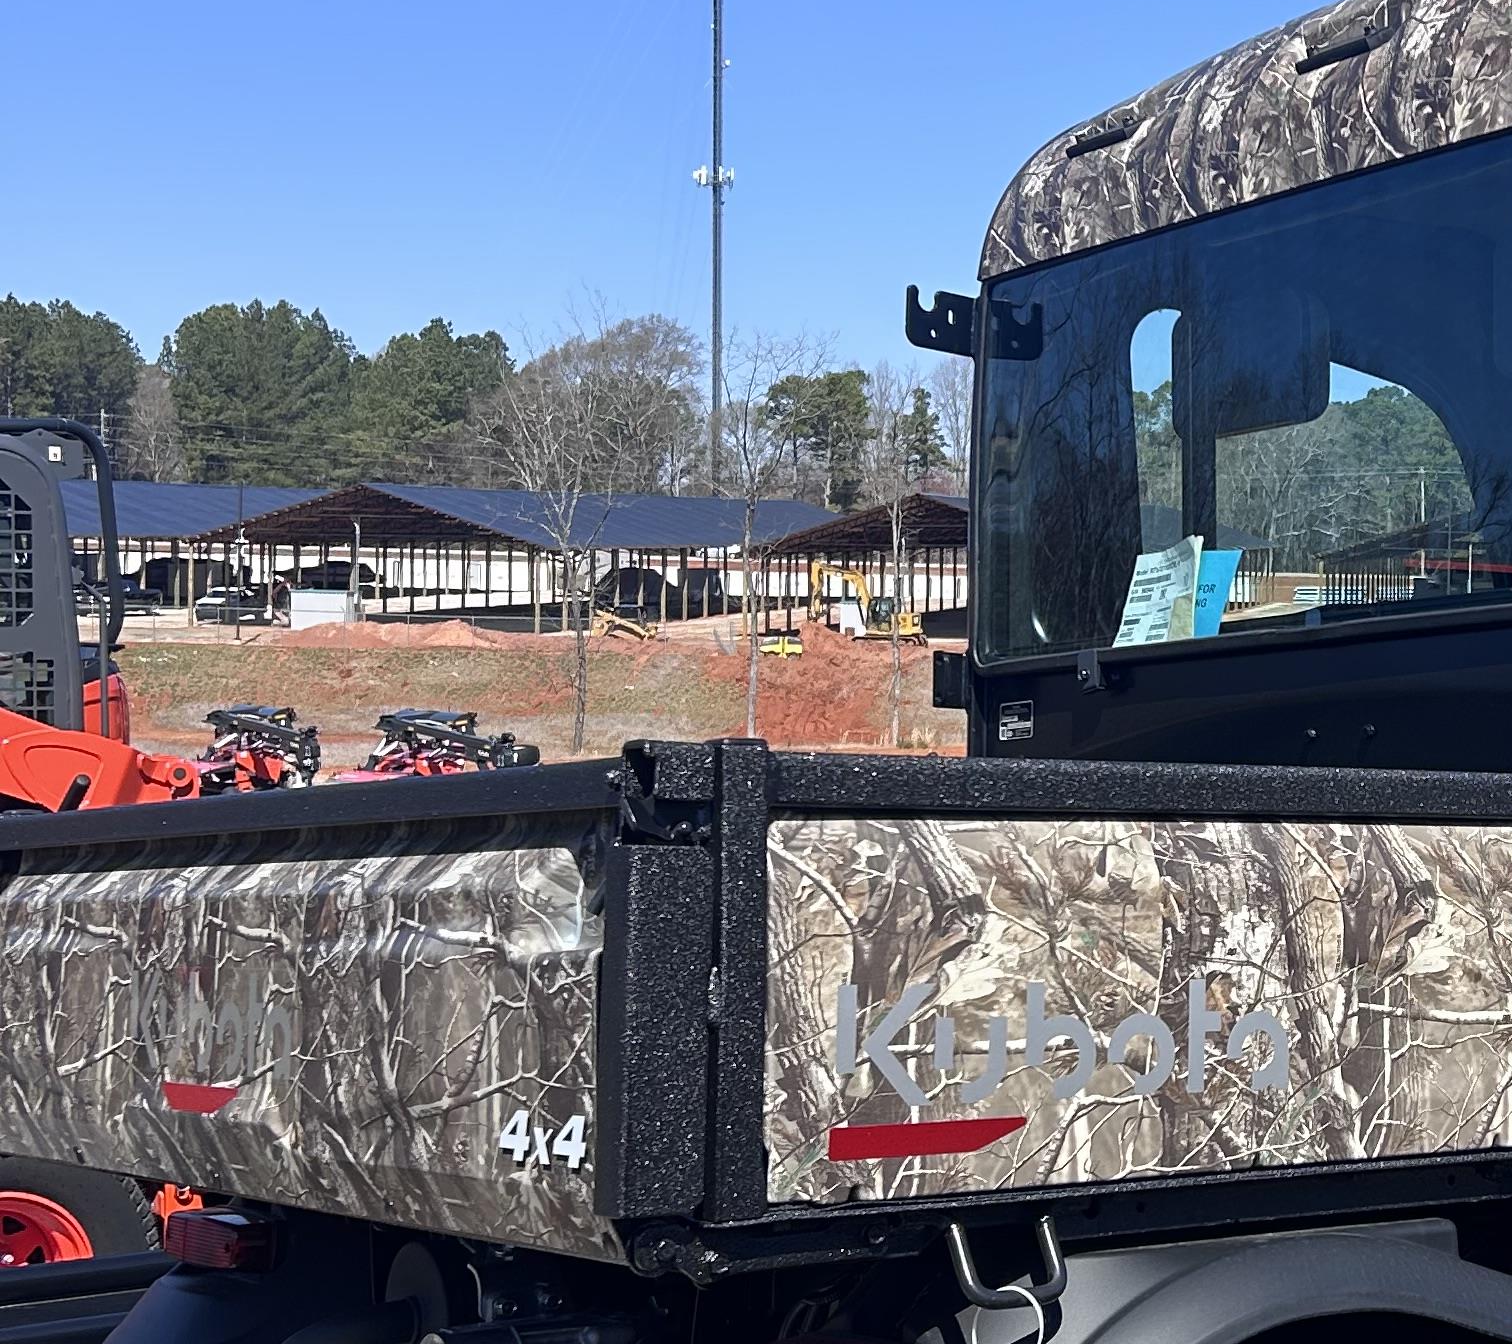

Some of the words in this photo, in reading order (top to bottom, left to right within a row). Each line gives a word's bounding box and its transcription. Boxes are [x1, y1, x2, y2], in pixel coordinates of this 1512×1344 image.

[1199, 584, 1216, 594] FOR
[129, 969, 291, 1080] Kubota
[836, 979, 1289, 1105] Kubota
[499, 1110, 586, 1168] 4x4
